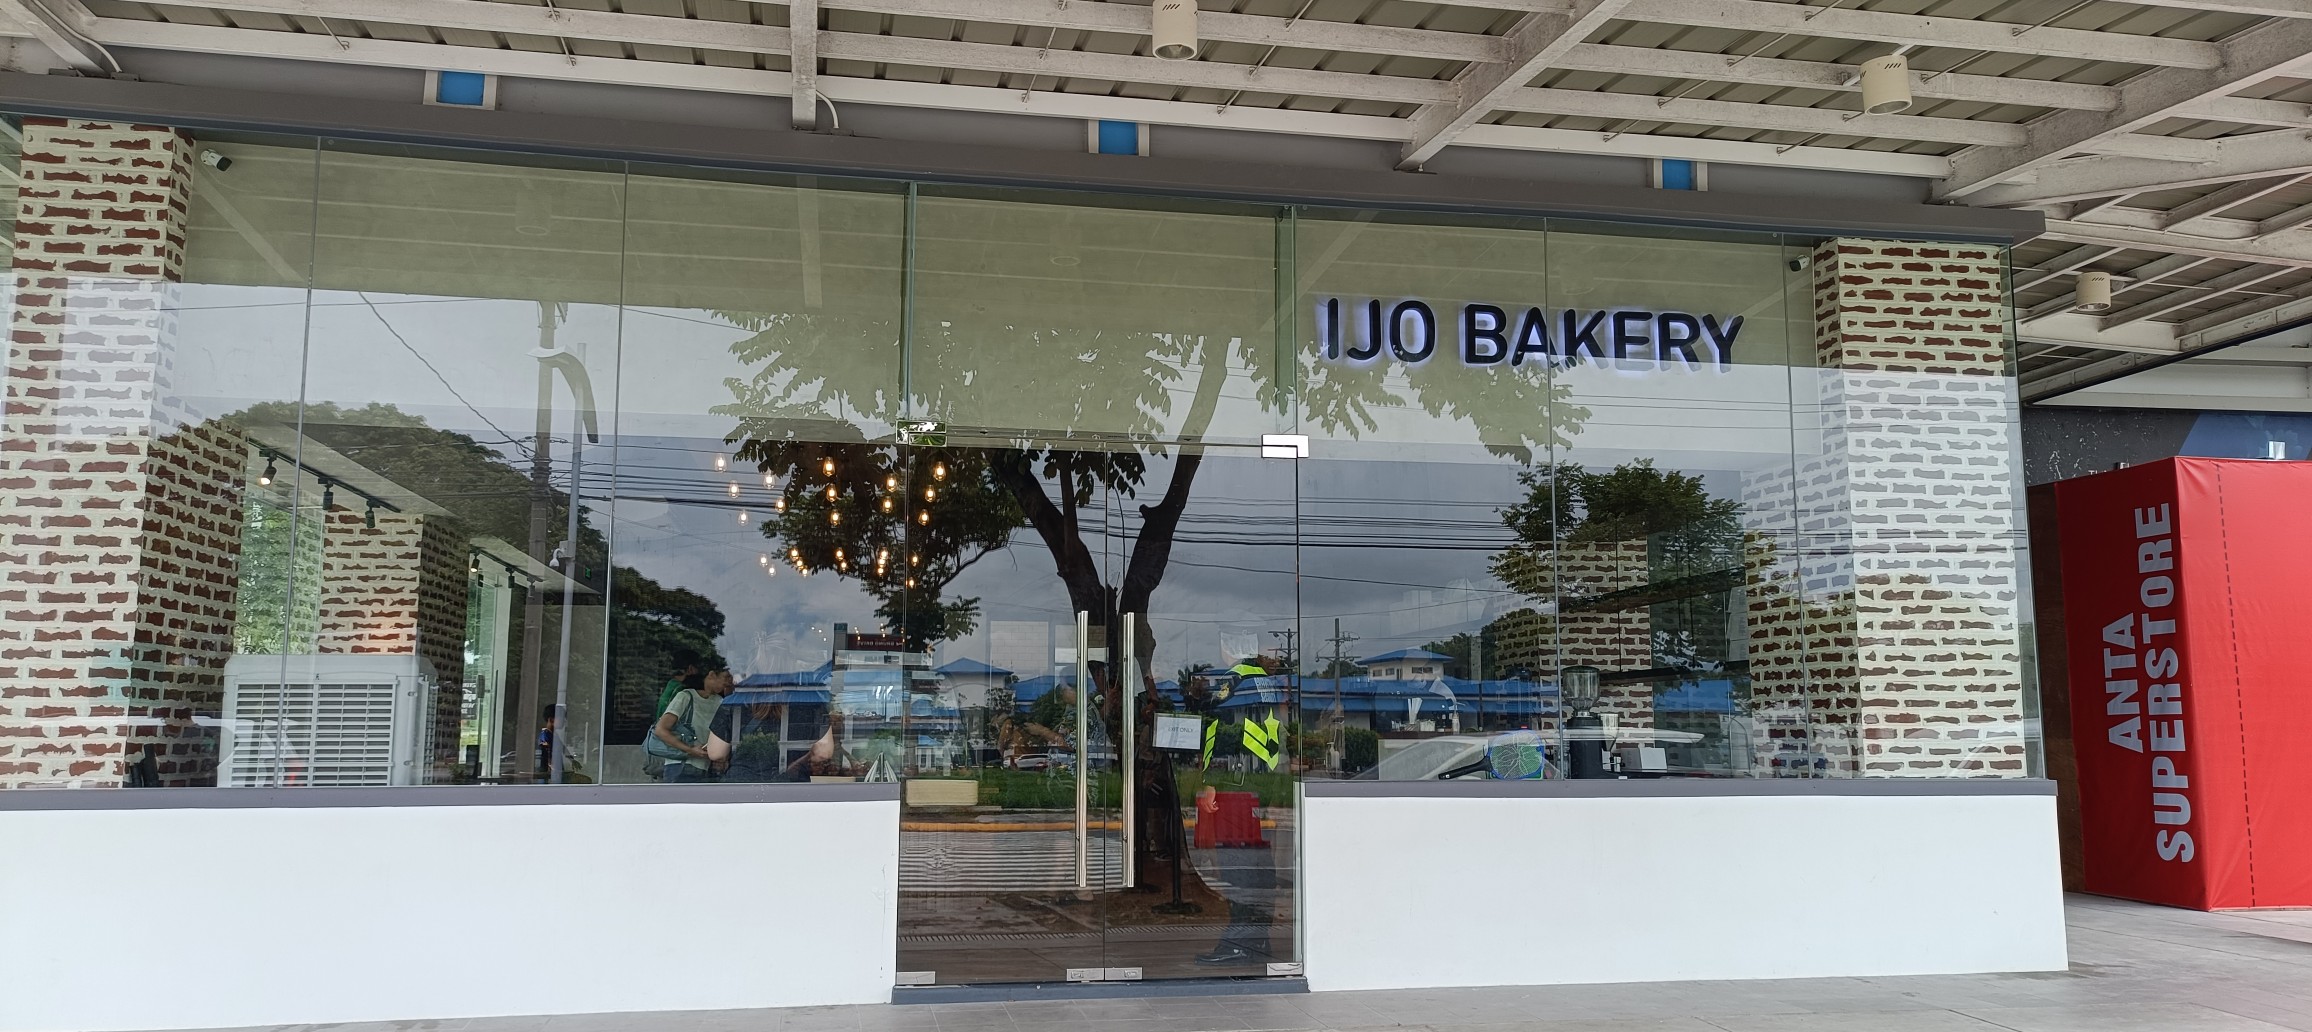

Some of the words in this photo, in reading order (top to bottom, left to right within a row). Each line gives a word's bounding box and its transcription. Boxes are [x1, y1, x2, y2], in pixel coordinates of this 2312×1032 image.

[1327, 297, 1436, 362] IJO
[1464, 303, 1744, 373] BAKERY
[2103, 612, 2144, 753] ANTA
[2134, 502, 2195, 863] SUPERSTORE
